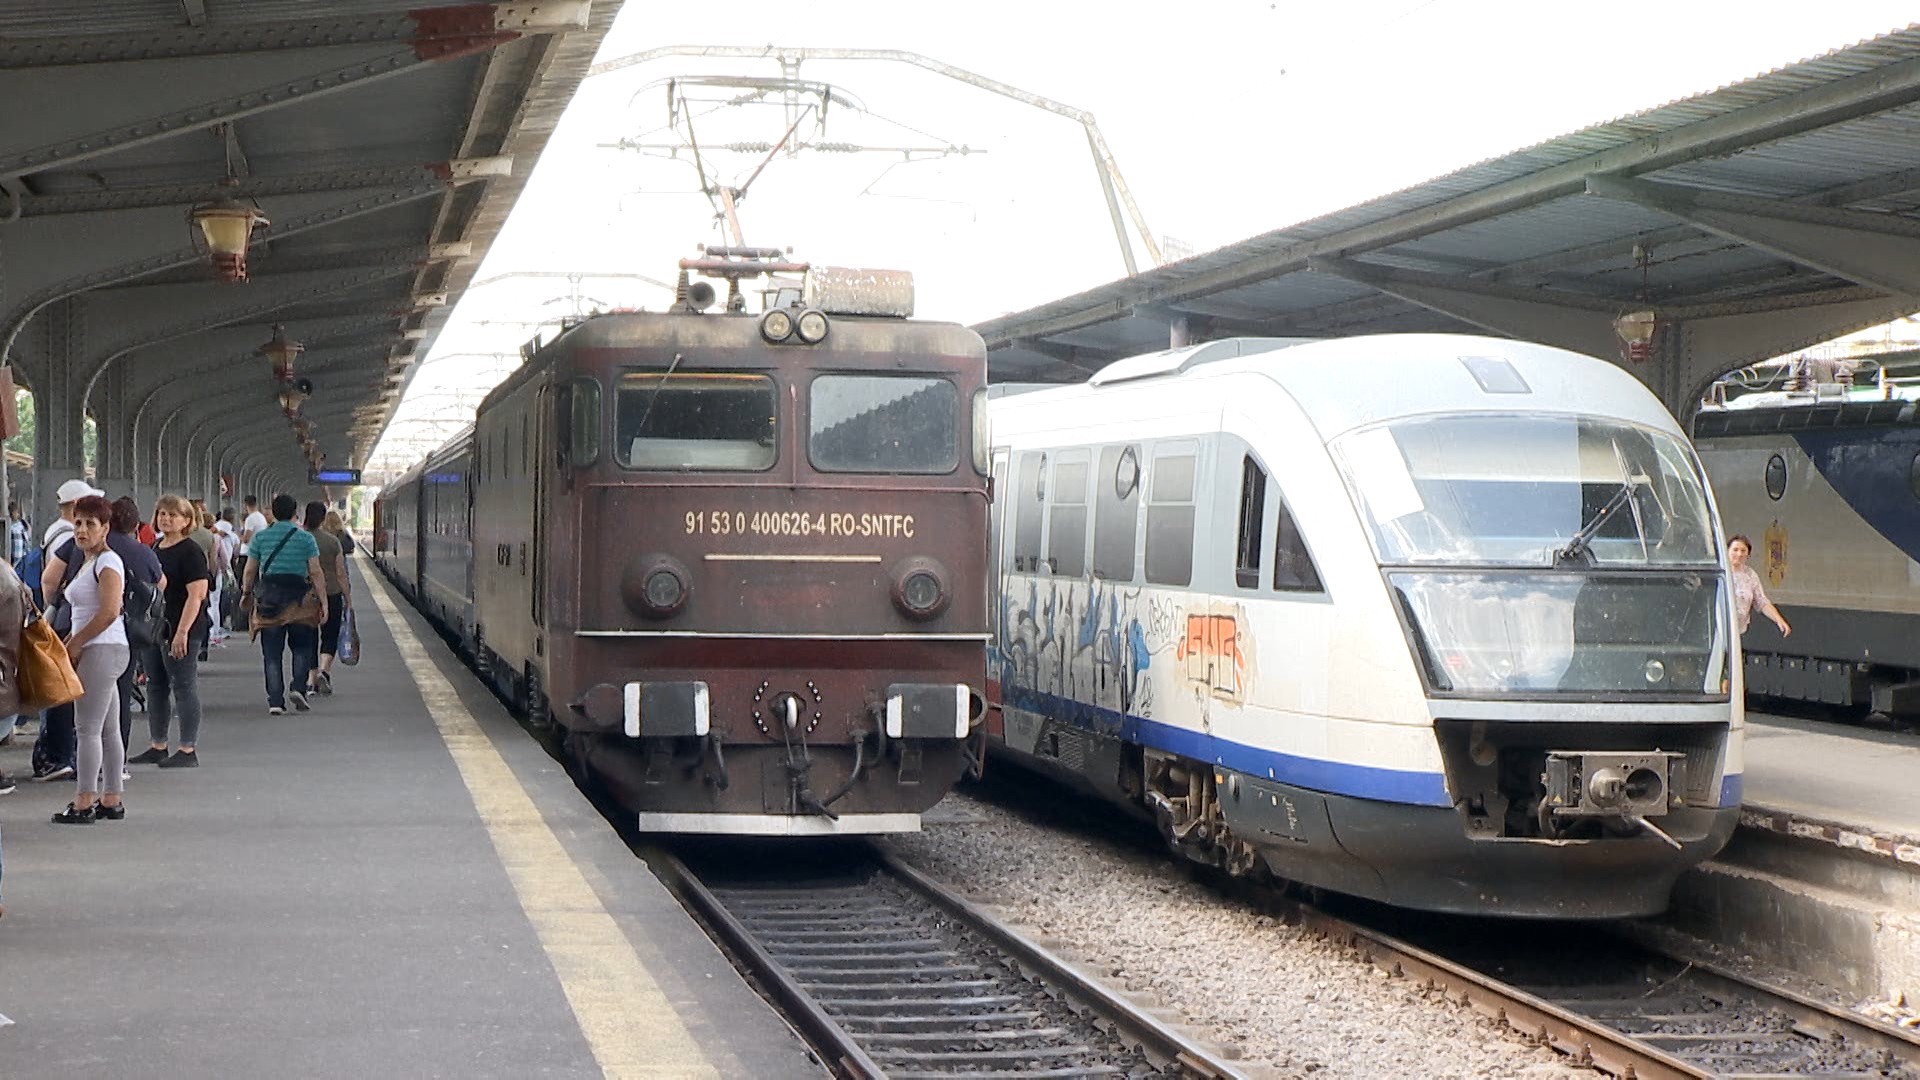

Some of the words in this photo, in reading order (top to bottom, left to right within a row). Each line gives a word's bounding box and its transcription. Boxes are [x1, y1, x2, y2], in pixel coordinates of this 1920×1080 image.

[685, 511, 704, 534] 91
[711, 511, 731, 534] 53
[735, 511, 746, 534] 0
[751, 511, 826, 535] 400626-4
[830, 513, 914, 538] RO-SNTFC
